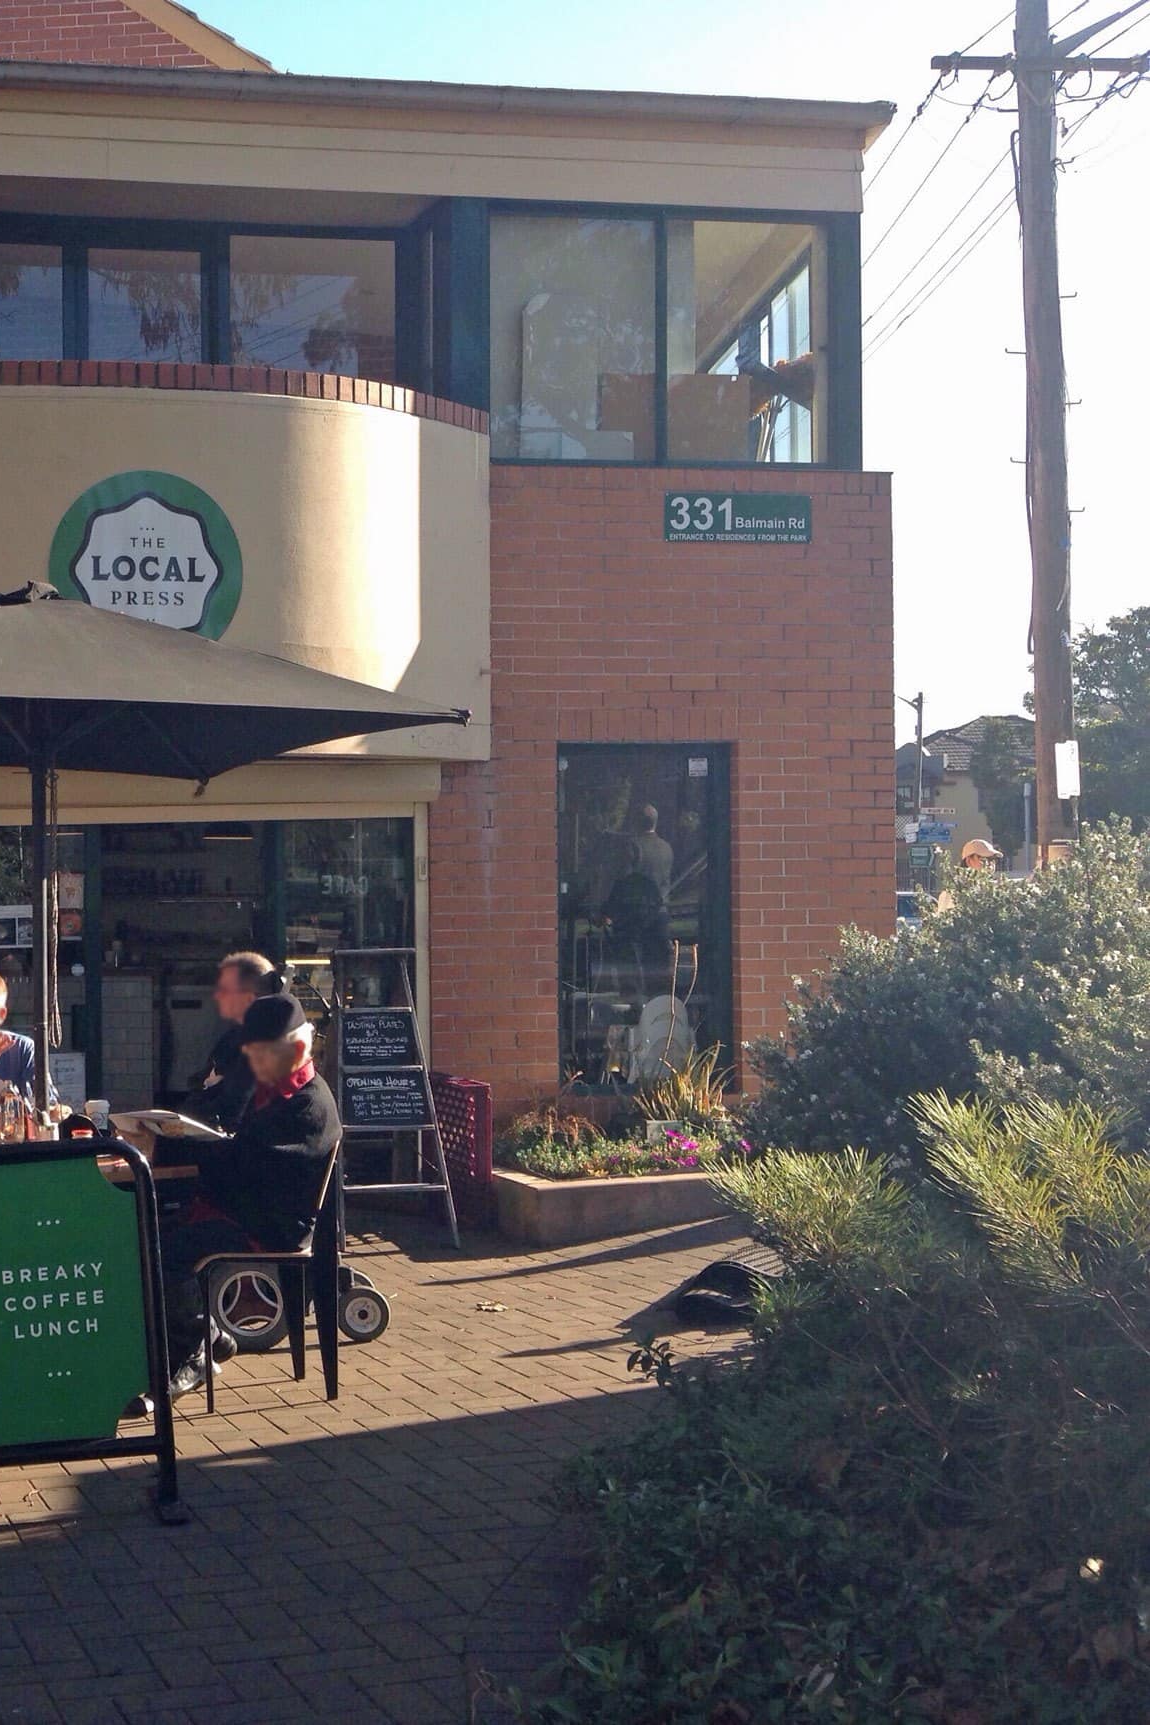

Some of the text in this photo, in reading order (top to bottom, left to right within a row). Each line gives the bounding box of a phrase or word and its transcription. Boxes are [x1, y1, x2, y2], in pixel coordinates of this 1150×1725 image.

[670, 496, 805, 531] 331 Balmain Rd
[129, 537, 166, 549] THE
[669, 533, 807, 542] ENTRANCE TO RESIDENCES FROM THE PARK
[91, 555, 206, 583] LOCAL
[111, 591, 185, 607] PRESS
[346, 1075, 417, 1088] OPENING HOURS
[1, 1262, 103, 1285] BREAKY
[4, 1289, 105, 1312] COFFEE
[14, 1317, 98, 1339] LUNCH
